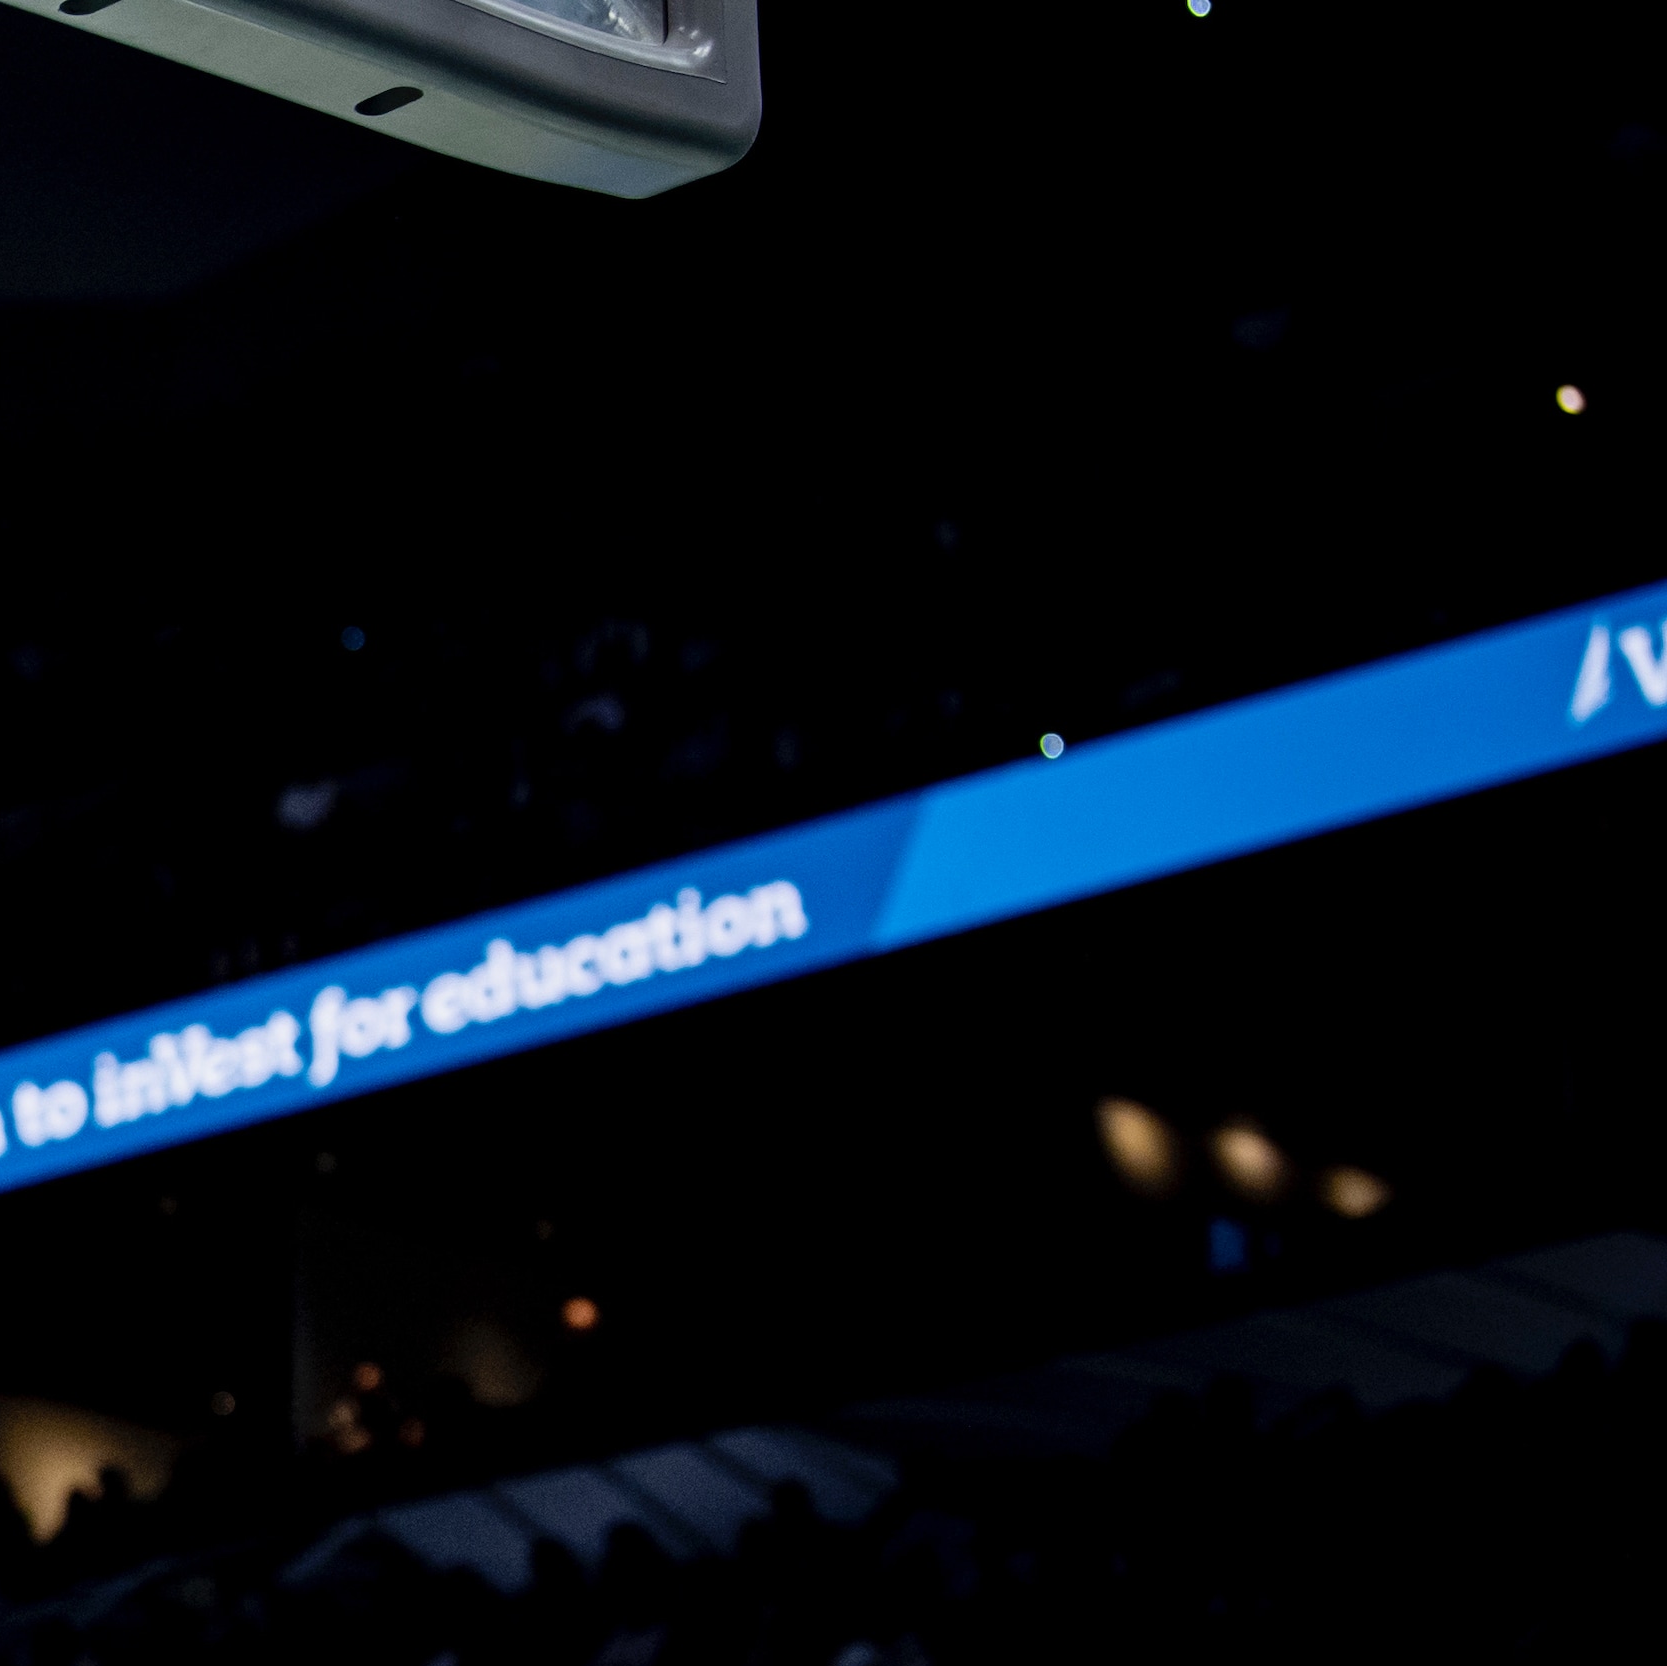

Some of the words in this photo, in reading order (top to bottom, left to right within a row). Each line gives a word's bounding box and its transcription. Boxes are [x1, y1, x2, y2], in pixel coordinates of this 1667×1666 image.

[12, 1080, 89, 1148] to
[306, 985, 418, 1089] for
[421, 879, 809, 1035] education
